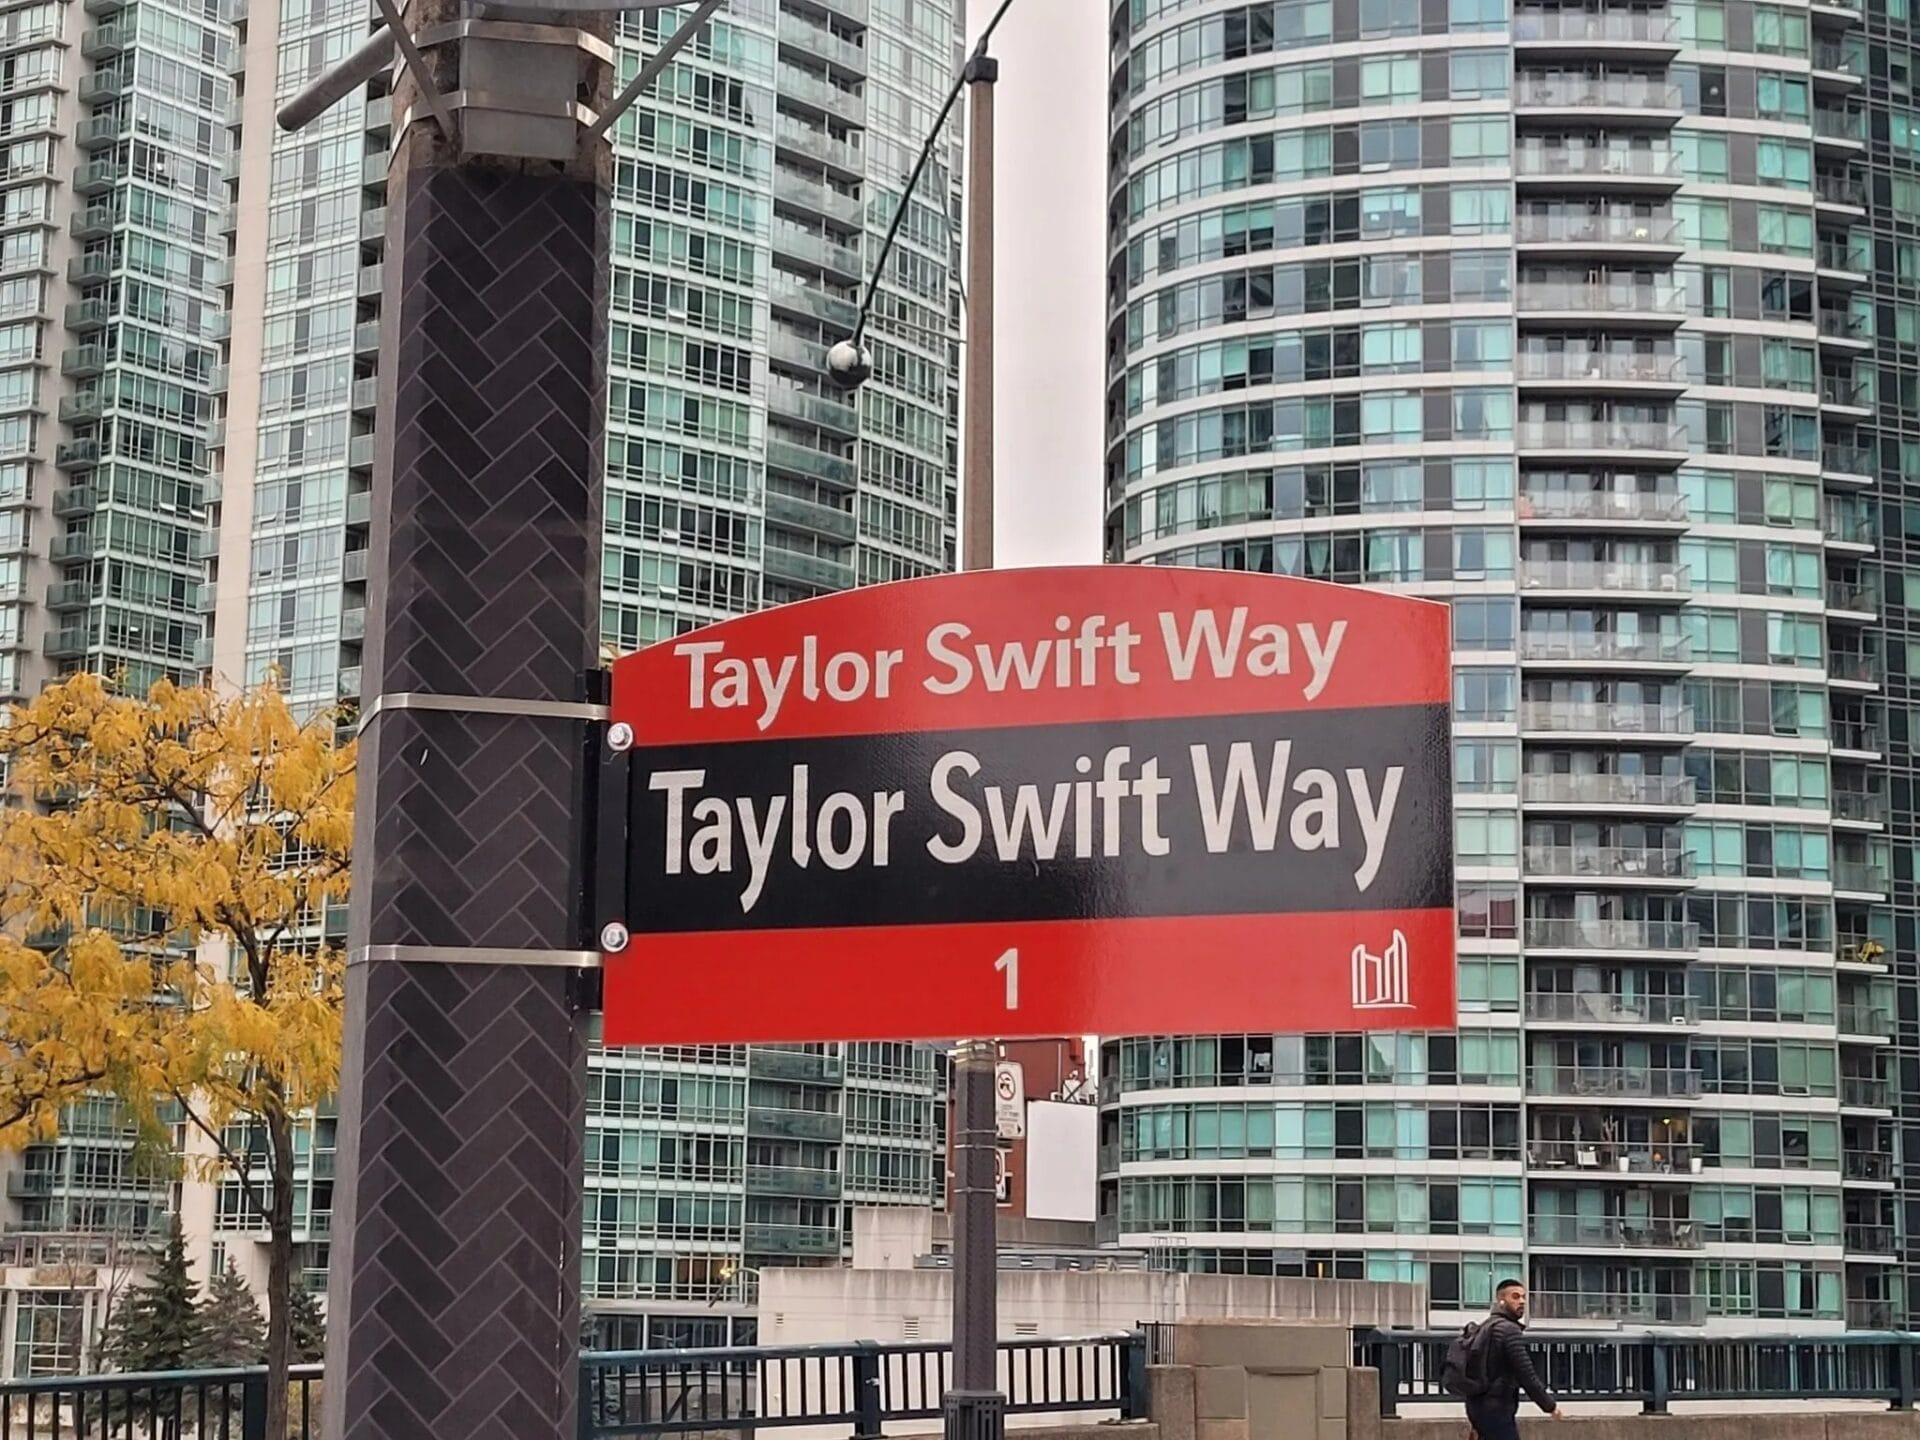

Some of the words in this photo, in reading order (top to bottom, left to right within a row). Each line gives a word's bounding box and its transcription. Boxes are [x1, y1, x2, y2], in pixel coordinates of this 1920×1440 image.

[674, 635, 904, 731] Taylor
[923, 615, 1142, 695] Swift
[1158, 606, 1348, 702] Way
[648, 764, 905, 913] Taylor
[926, 746, 1171, 863] Swift
[1189, 739, 1404, 892] Way
[994, 948, 1018, 1010] 1
